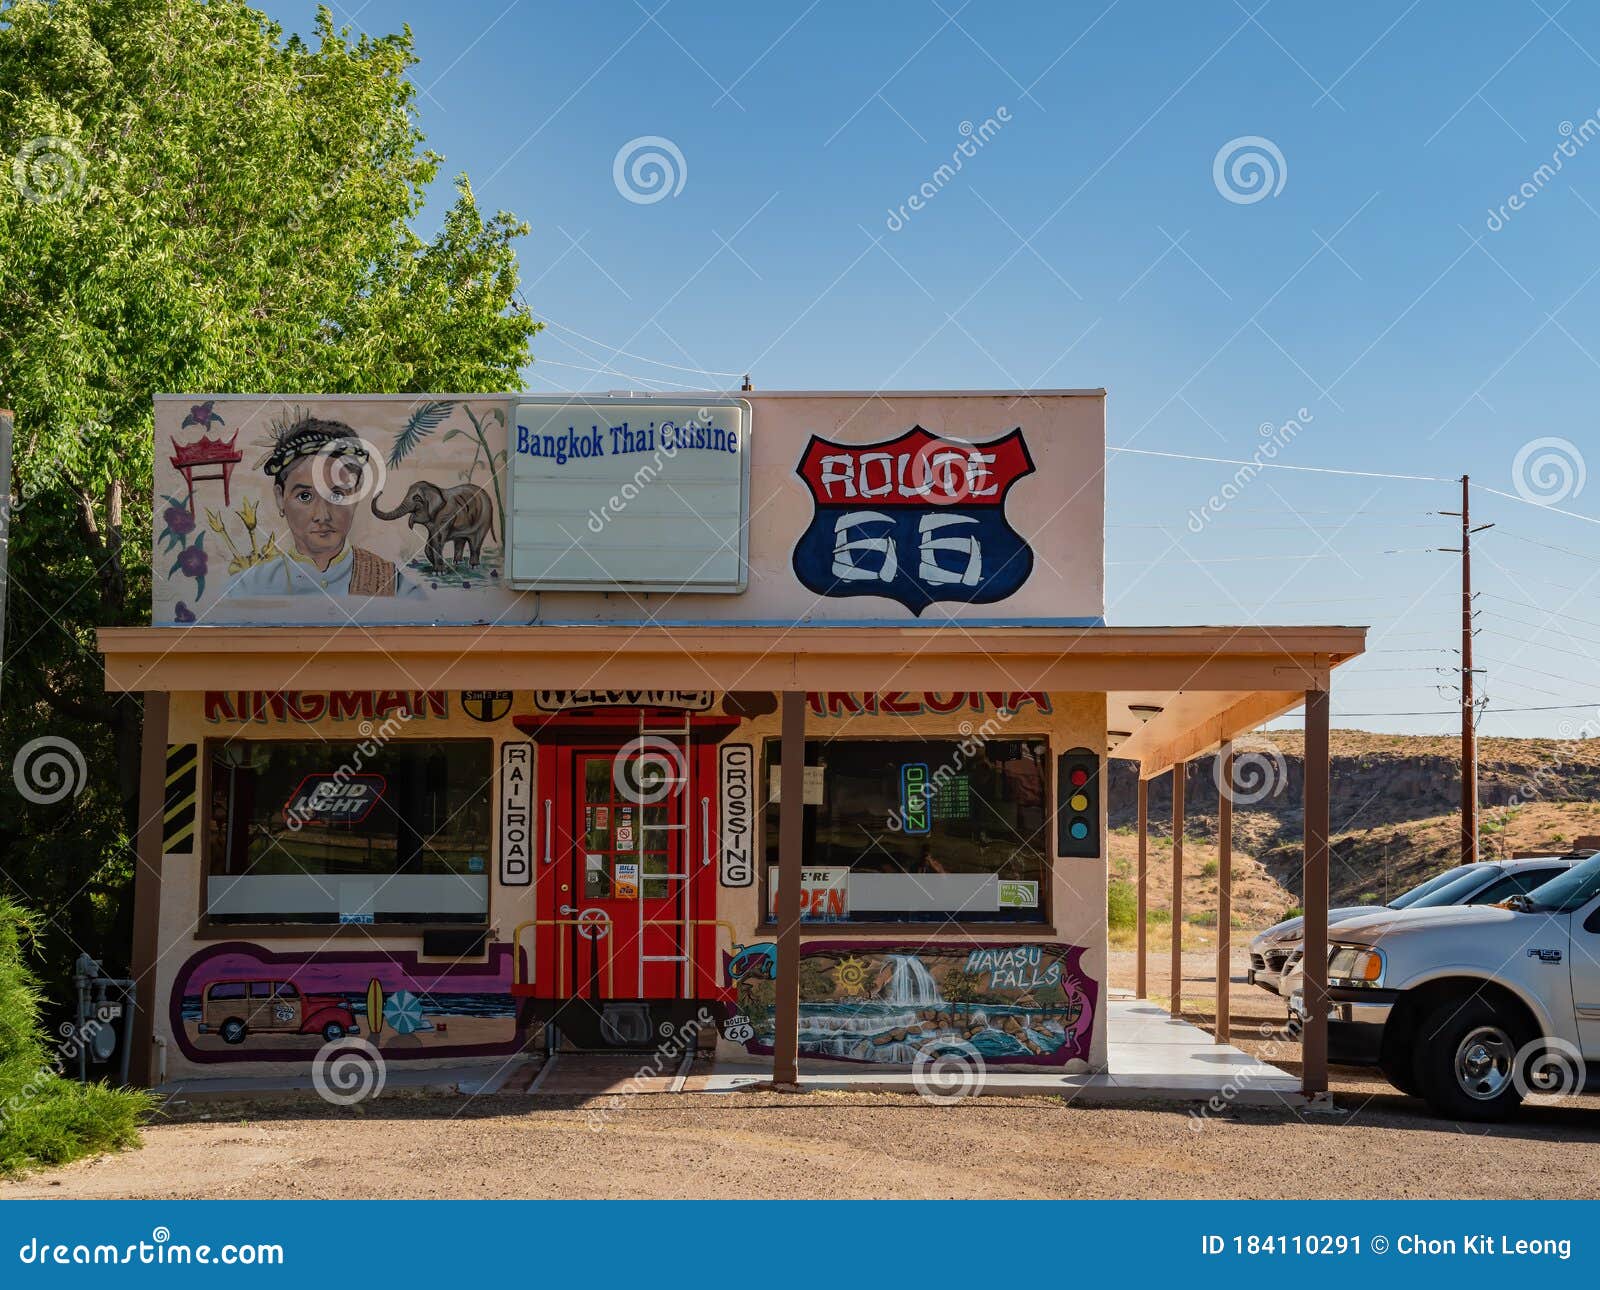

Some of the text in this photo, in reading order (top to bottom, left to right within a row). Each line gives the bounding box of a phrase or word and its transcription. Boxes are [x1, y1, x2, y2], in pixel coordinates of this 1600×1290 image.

[517, 421, 738, 465] Bangkok Thai Cuisine
[819, 451, 999, 499] ROUTE
[831, 510, 985, 586] 66
[203, 690, 449, 724] KINGMAN
[507, 749, 526, 875] RAILROAD
[907, 768, 926, 830] OPEN
[726, 751, 747, 882] CROSSING
[801, 872, 831, 882] E'RE
[773, 887, 847, 918] PEN
[966, 948, 1041, 972] HAVASU
[991, 964, 1061, 988] FALLS
[724, 1015, 750, 1027] ROUTE
[730, 1026, 749, 1039] 66
